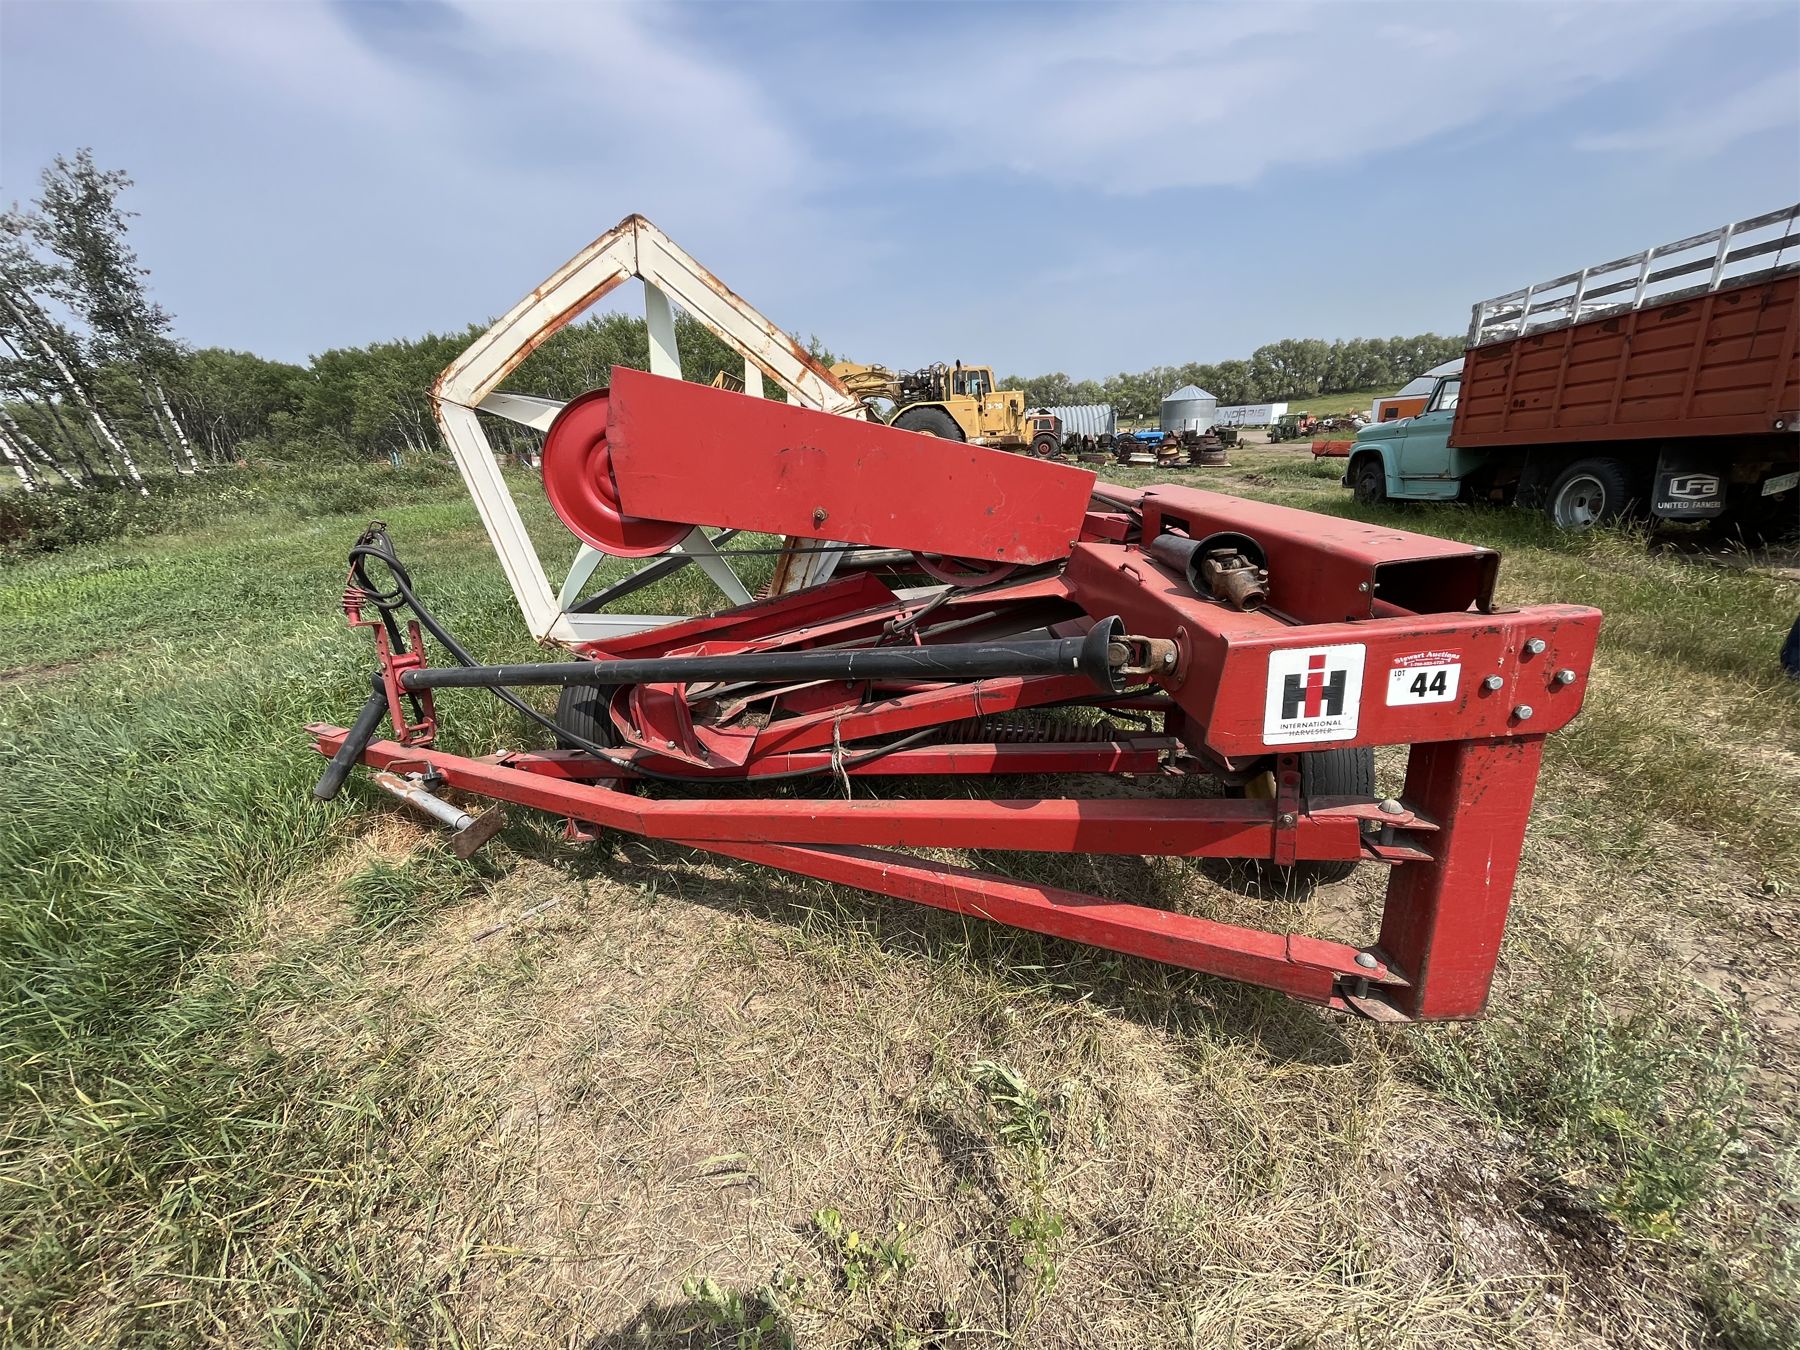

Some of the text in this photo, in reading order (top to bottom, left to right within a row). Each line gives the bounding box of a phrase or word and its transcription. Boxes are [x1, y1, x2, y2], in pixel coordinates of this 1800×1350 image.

[1657, 501, 1689, 509] UNITED
[1394, 652, 1425, 664] Stewart
[1426, 651, 1460, 660] Auctions
[1410, 670, 1447, 697] 44
[1280, 720, 1342, 730] INTERNATIONAL
[1288, 728, 1332, 737] HARVESTER
